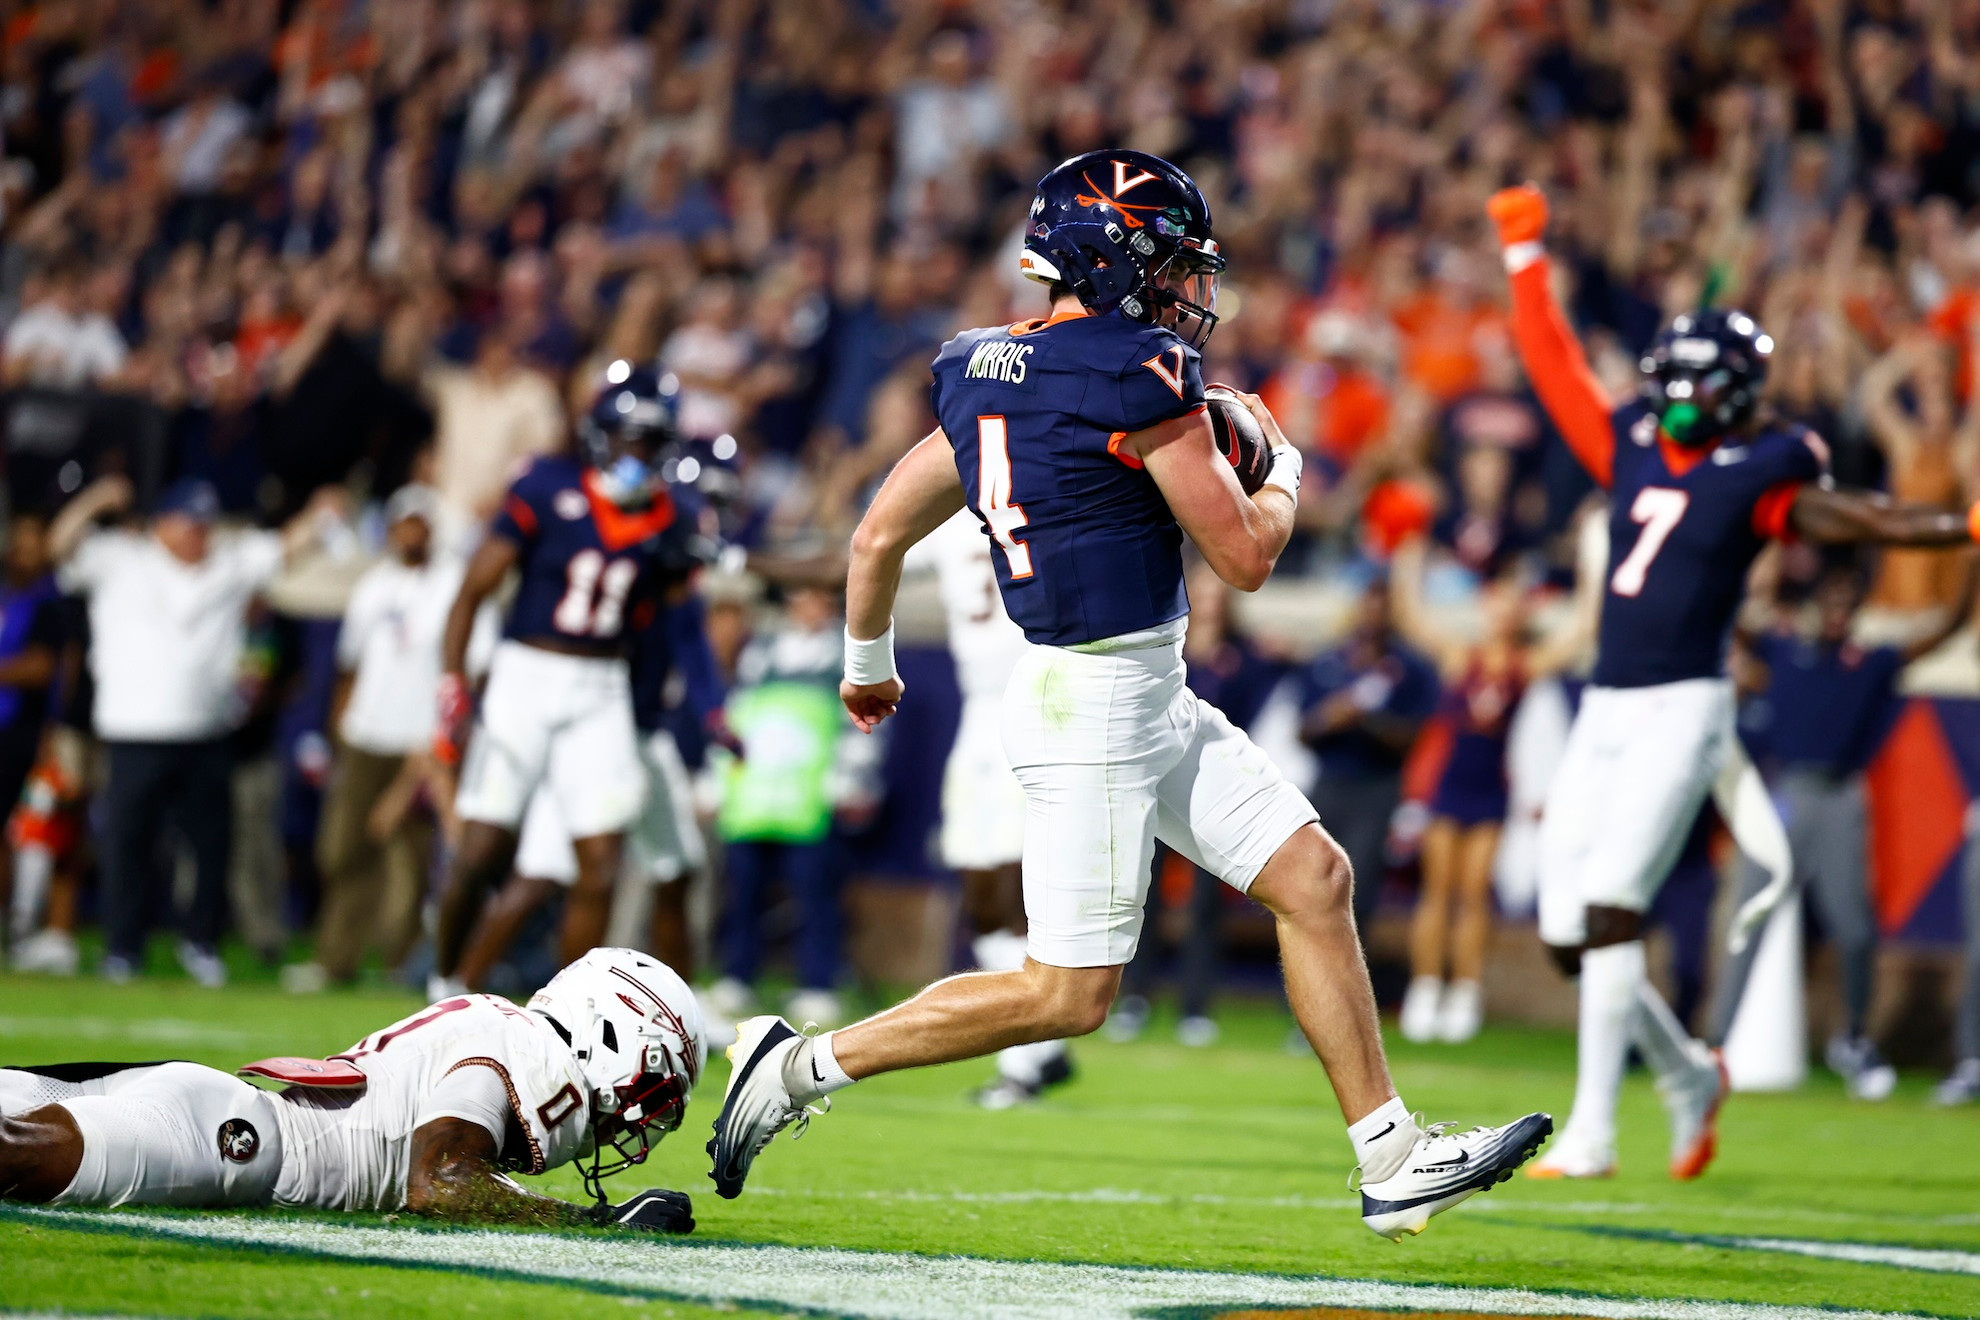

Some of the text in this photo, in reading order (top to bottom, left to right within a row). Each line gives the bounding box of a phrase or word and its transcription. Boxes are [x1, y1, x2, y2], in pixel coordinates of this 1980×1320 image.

[1110, 159, 1163, 199] V
[964, 341, 1034, 385] MORRIS
[1141, 344, 1184, 401] V
[976, 415, 1034, 580] 4
[1611, 486, 1689, 597] 7
[553, 548, 637, 637] 11
[536, 1081, 584, 1133] 0
